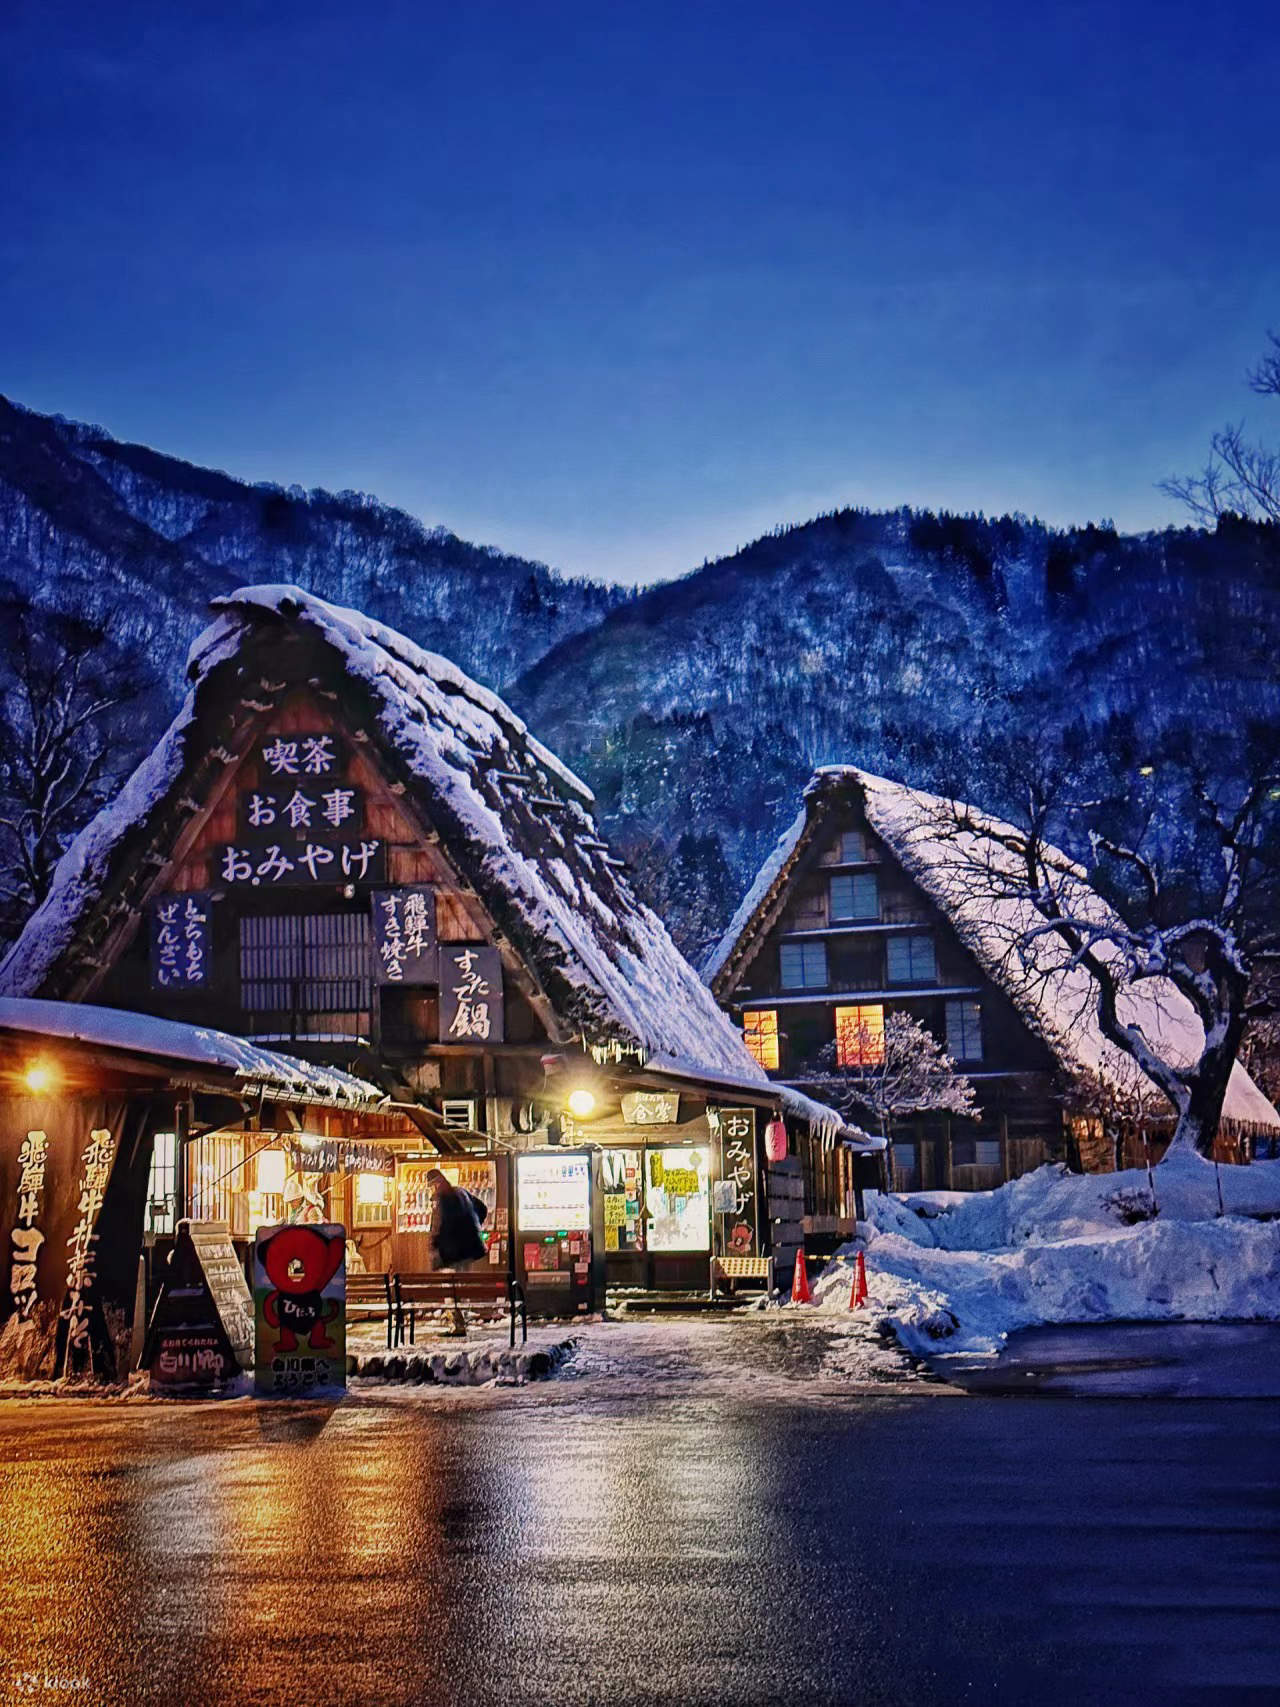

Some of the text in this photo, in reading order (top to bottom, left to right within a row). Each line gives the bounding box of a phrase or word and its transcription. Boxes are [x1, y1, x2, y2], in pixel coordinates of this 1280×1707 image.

[262, 735, 337, 775] 喫茶
[248, 788, 356, 828] お食事
[221, 840, 380, 881] おみやげ
[157, 903, 181, 985] ぜんざい
[184, 898, 204, 982] とちもち
[380, 894, 408, 981] すき焼き
[403, 893, 430, 958] 飛騨牛
[449, 949, 491, 1040] すったて鍋
[726, 1115, 755, 1216] おみやげ
